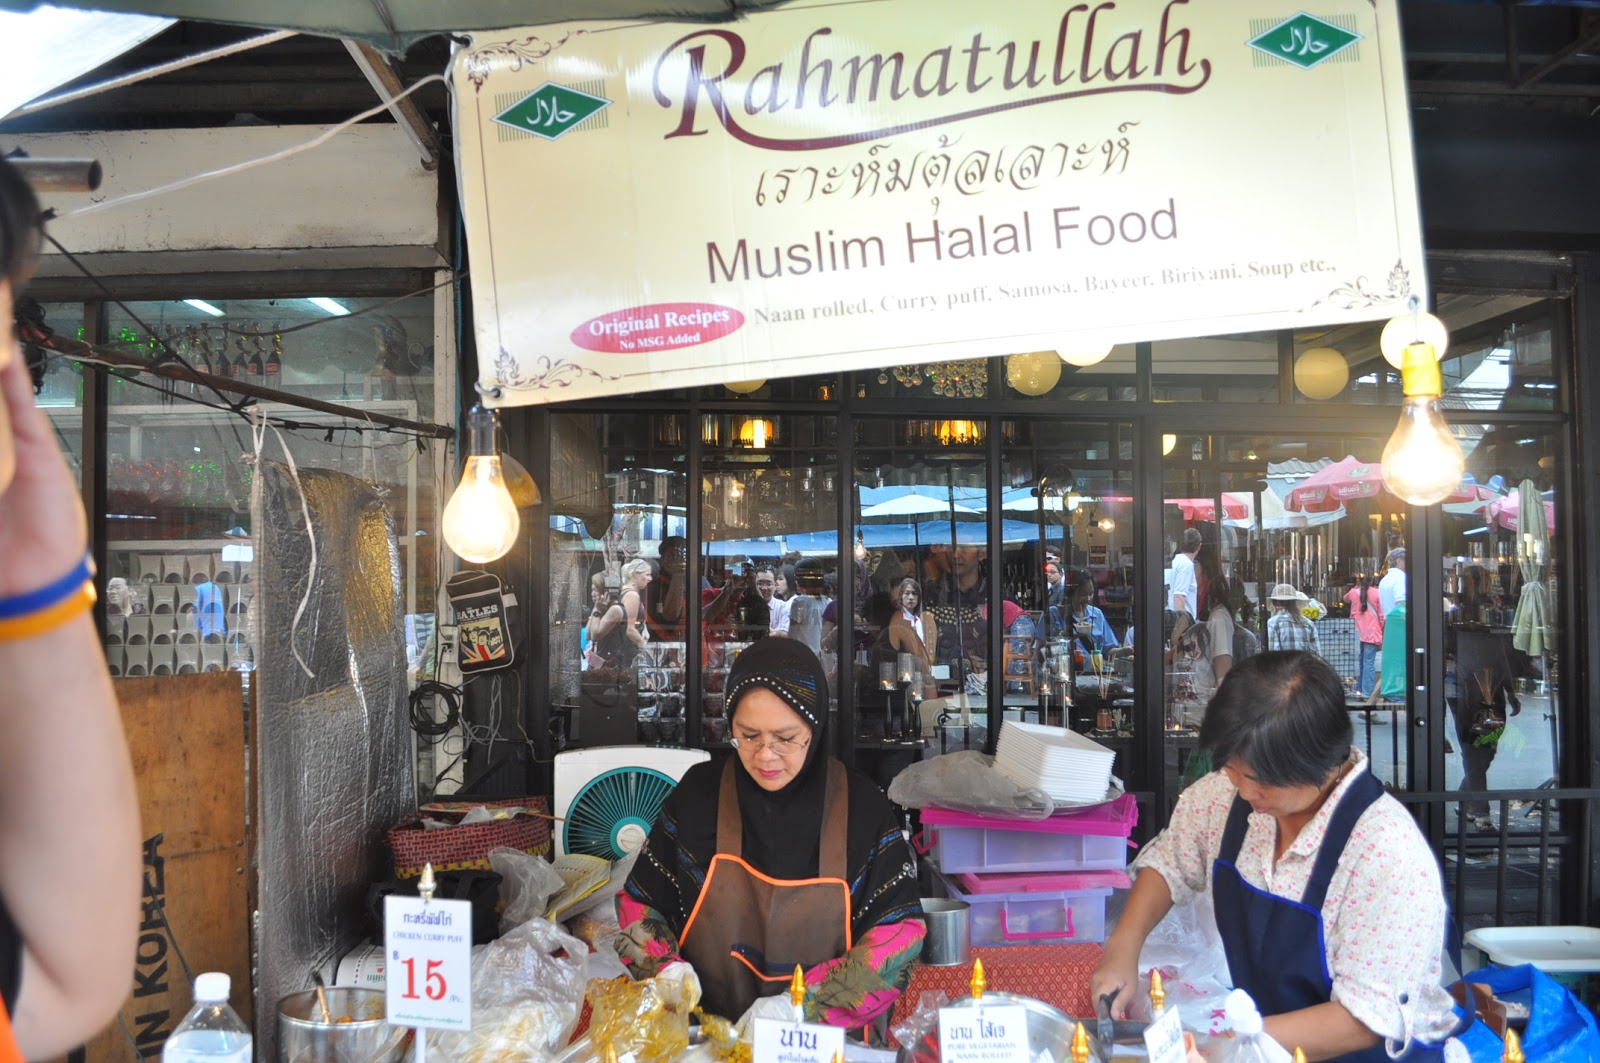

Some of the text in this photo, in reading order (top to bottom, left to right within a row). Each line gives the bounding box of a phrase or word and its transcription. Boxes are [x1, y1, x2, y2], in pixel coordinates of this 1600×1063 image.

[1280, 25, 1329, 56] حلال
[652, 0, 1212, 151] Rahmatullah
[525, 95, 577, 127] حلال
[706, 197, 1179, 284] Muslim Halal Food
[754, 307, 806, 325] Naan
[812, 299, 875, 319] rolled,
[880, 294, 940, 312] Curry
[946, 284, 992, 309] puff,
[998, 280, 1078, 300] Samosa,
[1247, 260, 1294, 279] Soup
[589, 308, 731, 337] Original Recipes
[620, 332, 701, 350] No MSG Added
[393, 930, 464, 943] CHICKEN CURRY PUFF
[401, 957, 447, 1001] 15
[780, 1028, 818, 1050] นาน
